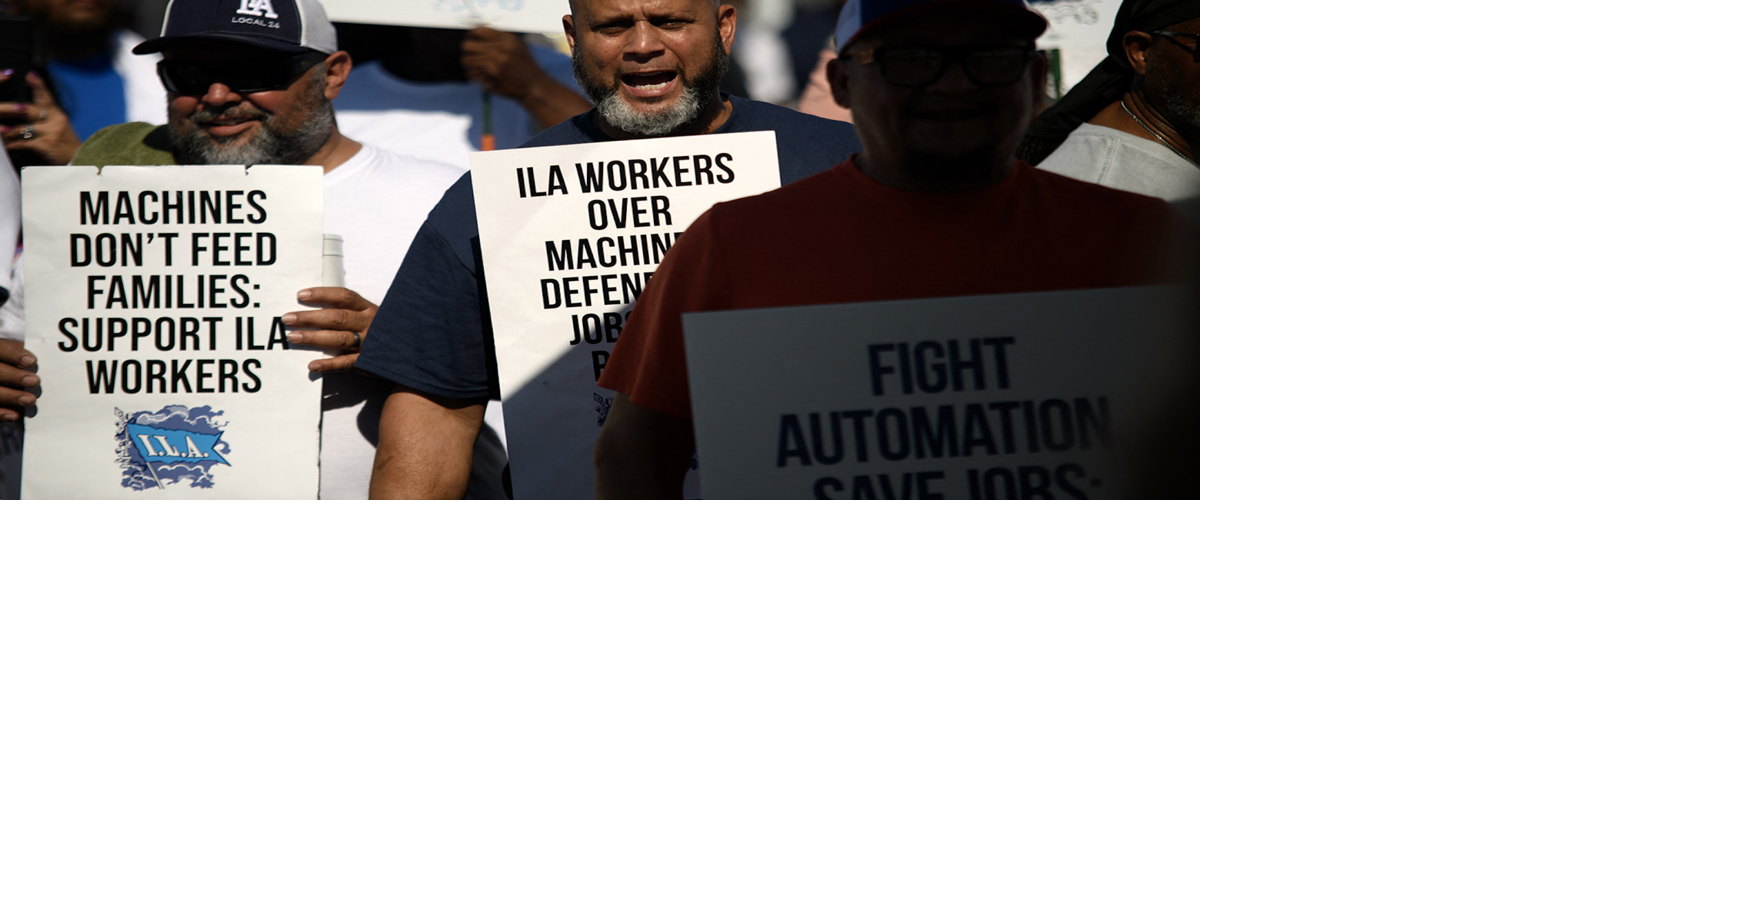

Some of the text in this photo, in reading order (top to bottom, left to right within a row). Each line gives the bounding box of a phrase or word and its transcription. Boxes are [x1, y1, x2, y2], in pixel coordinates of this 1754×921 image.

[231, 16, 267, 27] LOCAL
[516, 153, 735, 198] ILA WORKERS
[79, 190, 267, 225] MACHINES
[587, 195, 673, 231] OVER
[70, 232, 277, 268] DON'T FEED
[545, 232, 685, 271] MACHIN
[87, 274, 261, 309] FAMILIES:
[540, 272, 656, 310] DEFEN
[58, 316, 289, 351] SUPPORT ILA
[570, 310, 633, 346] JOB
[86, 358, 262, 394] WORKERS
[868, 336, 1015, 397] FIGHT
[137, 434, 210, 458] I.L.A.
[776, 396, 1112, 468] AUTOMATION
